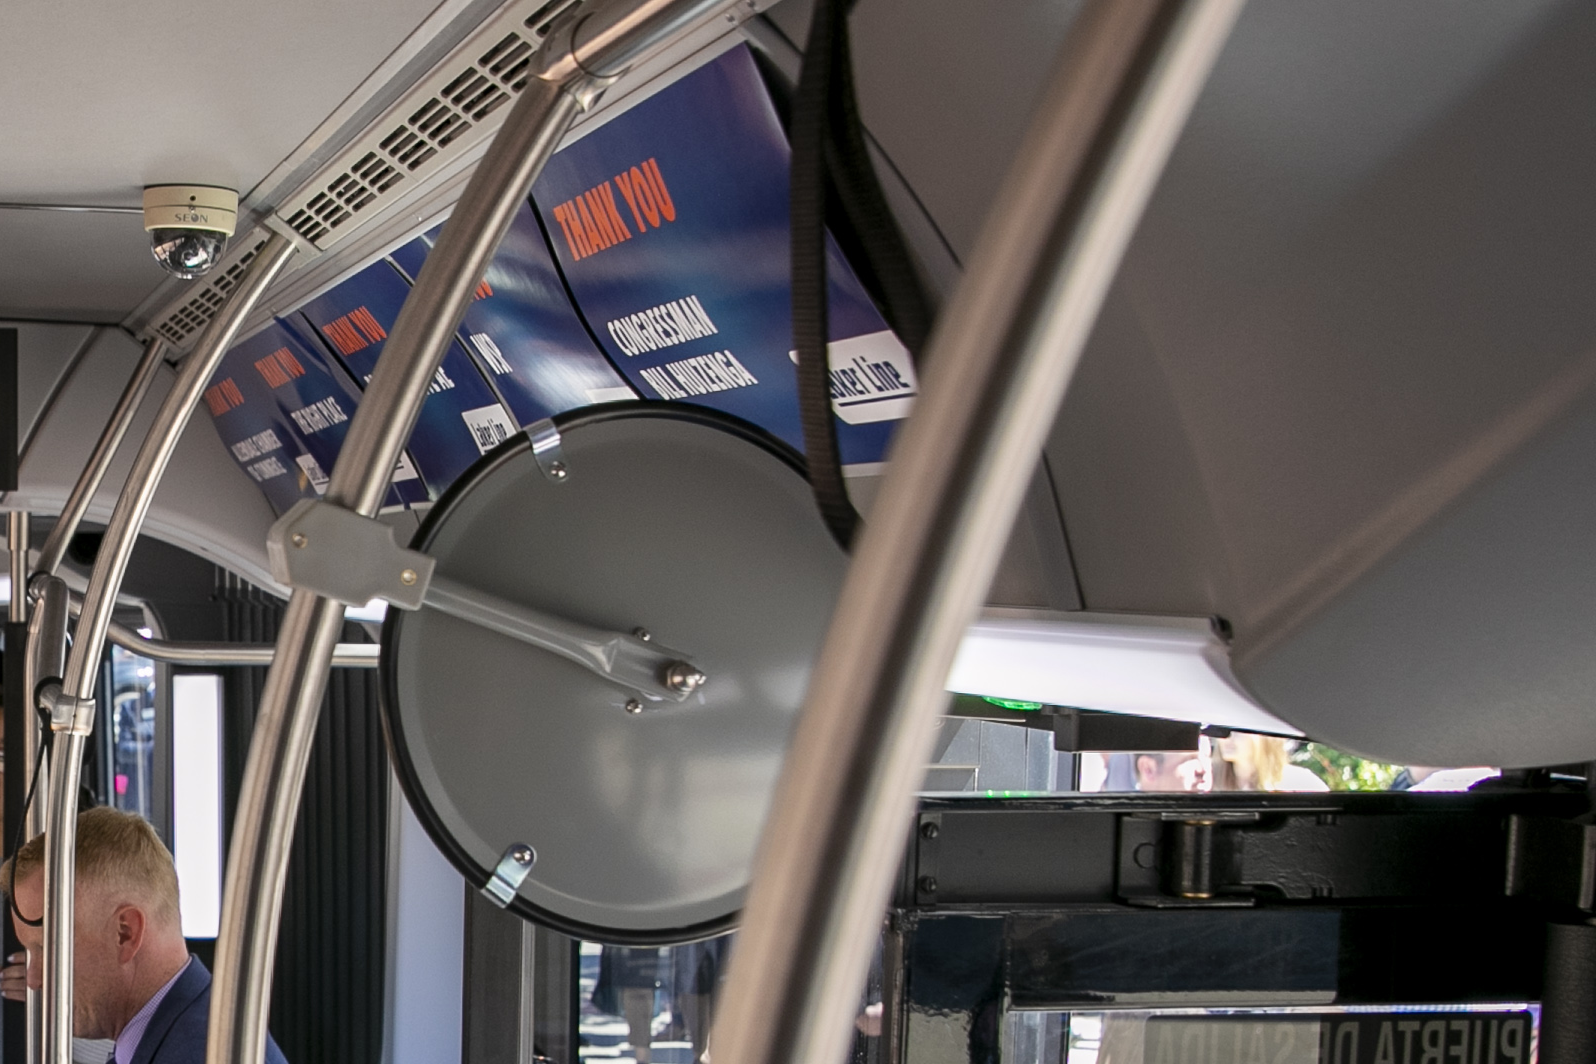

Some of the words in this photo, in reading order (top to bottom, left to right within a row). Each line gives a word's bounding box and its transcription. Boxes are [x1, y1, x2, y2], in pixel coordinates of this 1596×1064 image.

[174, 213, 209, 223] SEON
[552, 181, 633, 262] THANK
[614, 157, 676, 233] YOU
[348, 305, 388, 344] YOU
[607, 295, 719, 357] CONGRESSMAN
[639, 366, 689, 400] BILL
[665, 349, 759, 396] HUIZENGA
[828, 367, 872, 400] aker
[851, 355, 911, 393] Line
